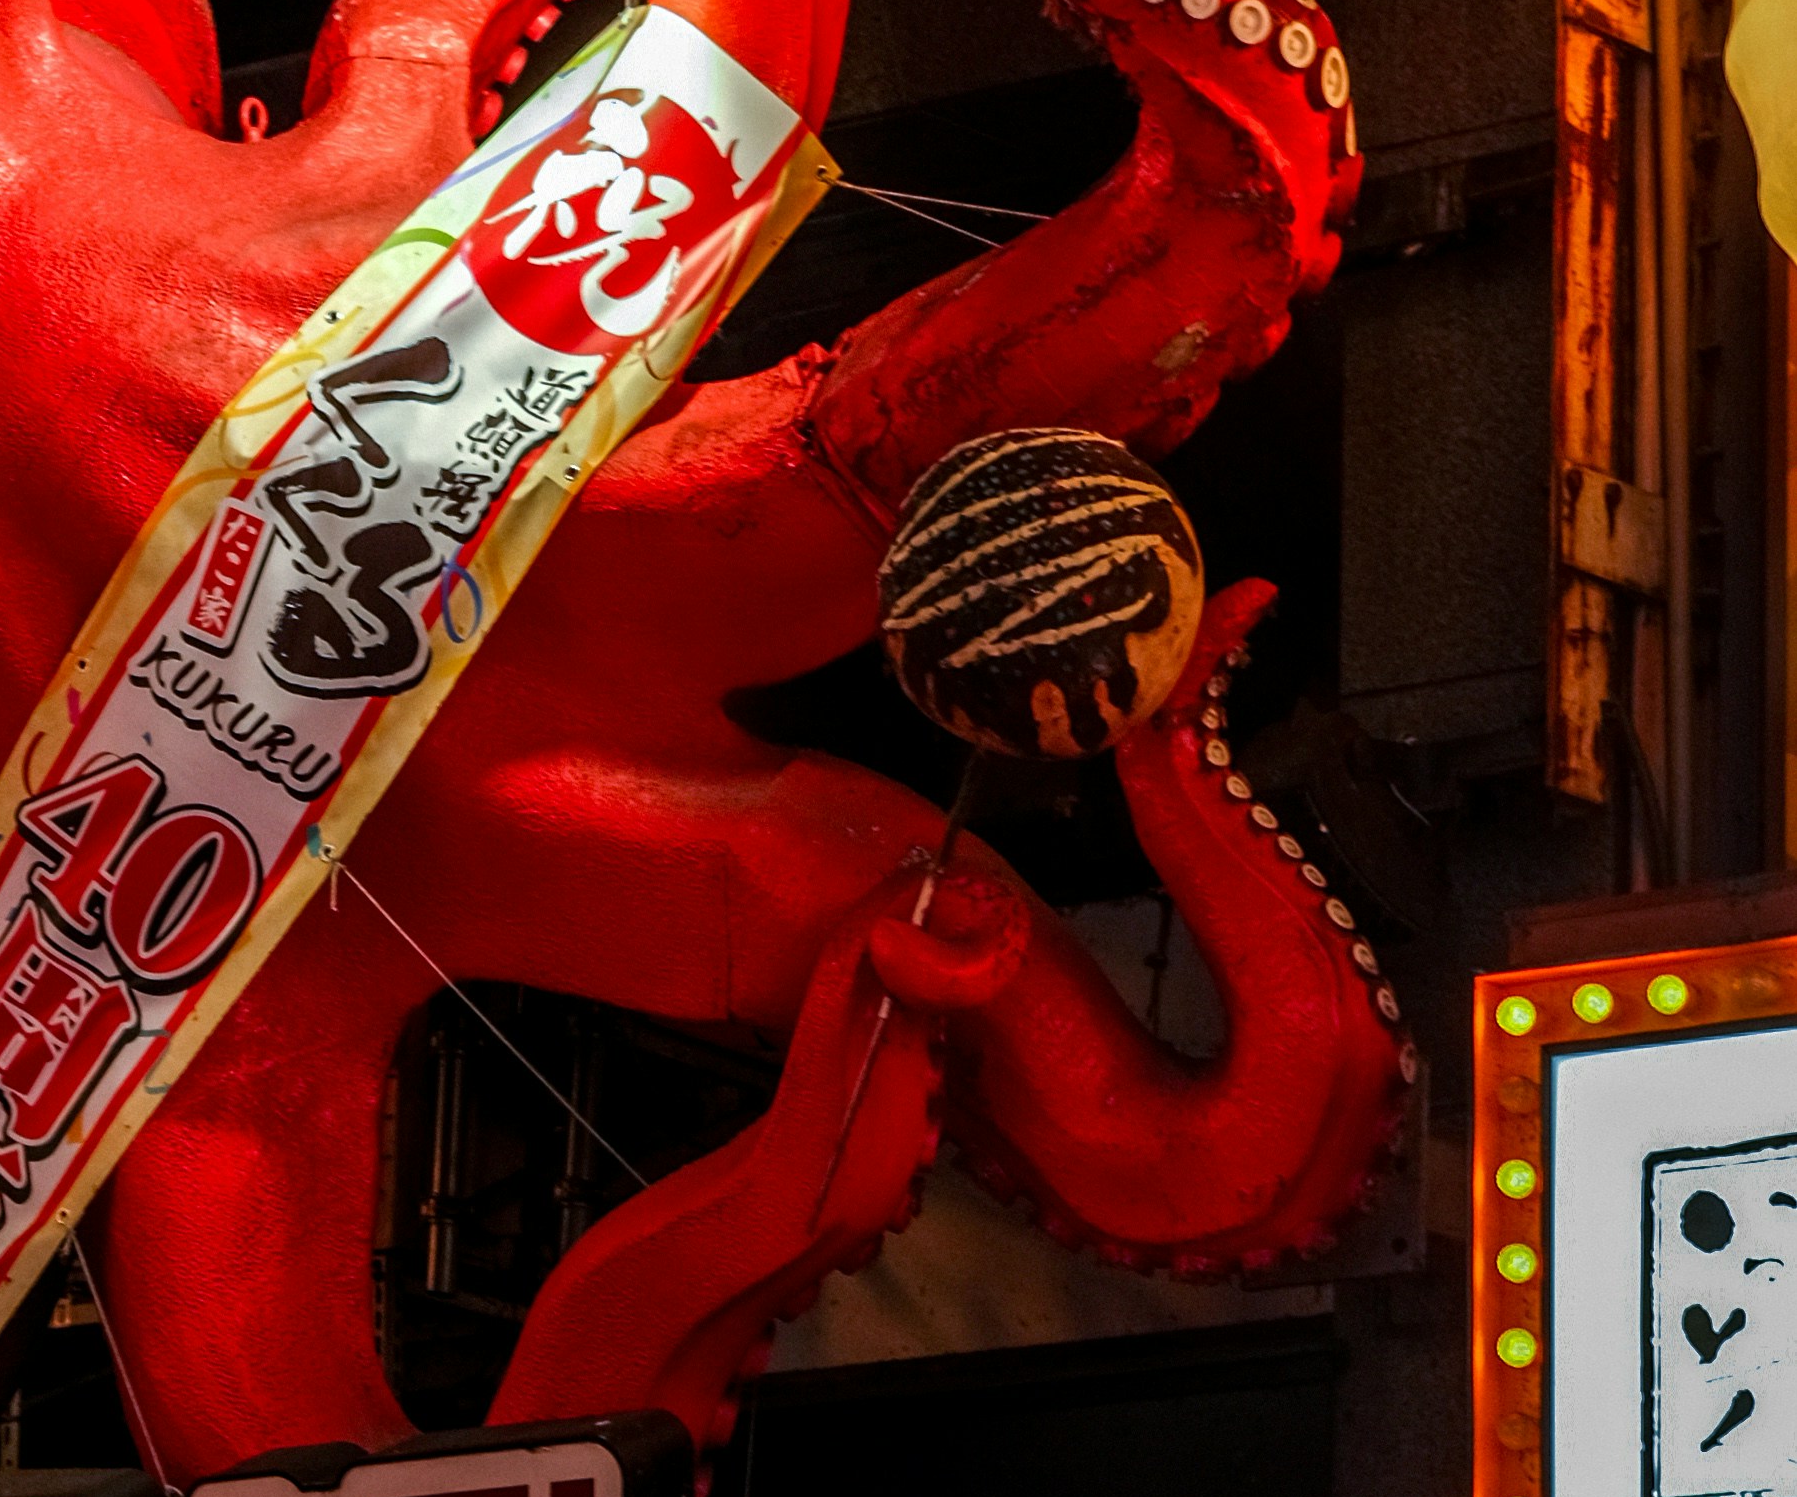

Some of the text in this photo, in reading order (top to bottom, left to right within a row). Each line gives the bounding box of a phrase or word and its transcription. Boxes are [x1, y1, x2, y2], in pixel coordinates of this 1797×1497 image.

[199, 513, 262, 636] たこ家
[262, 337, 455, 694] くくる
[139, 634, 340, 790] KUKURU
